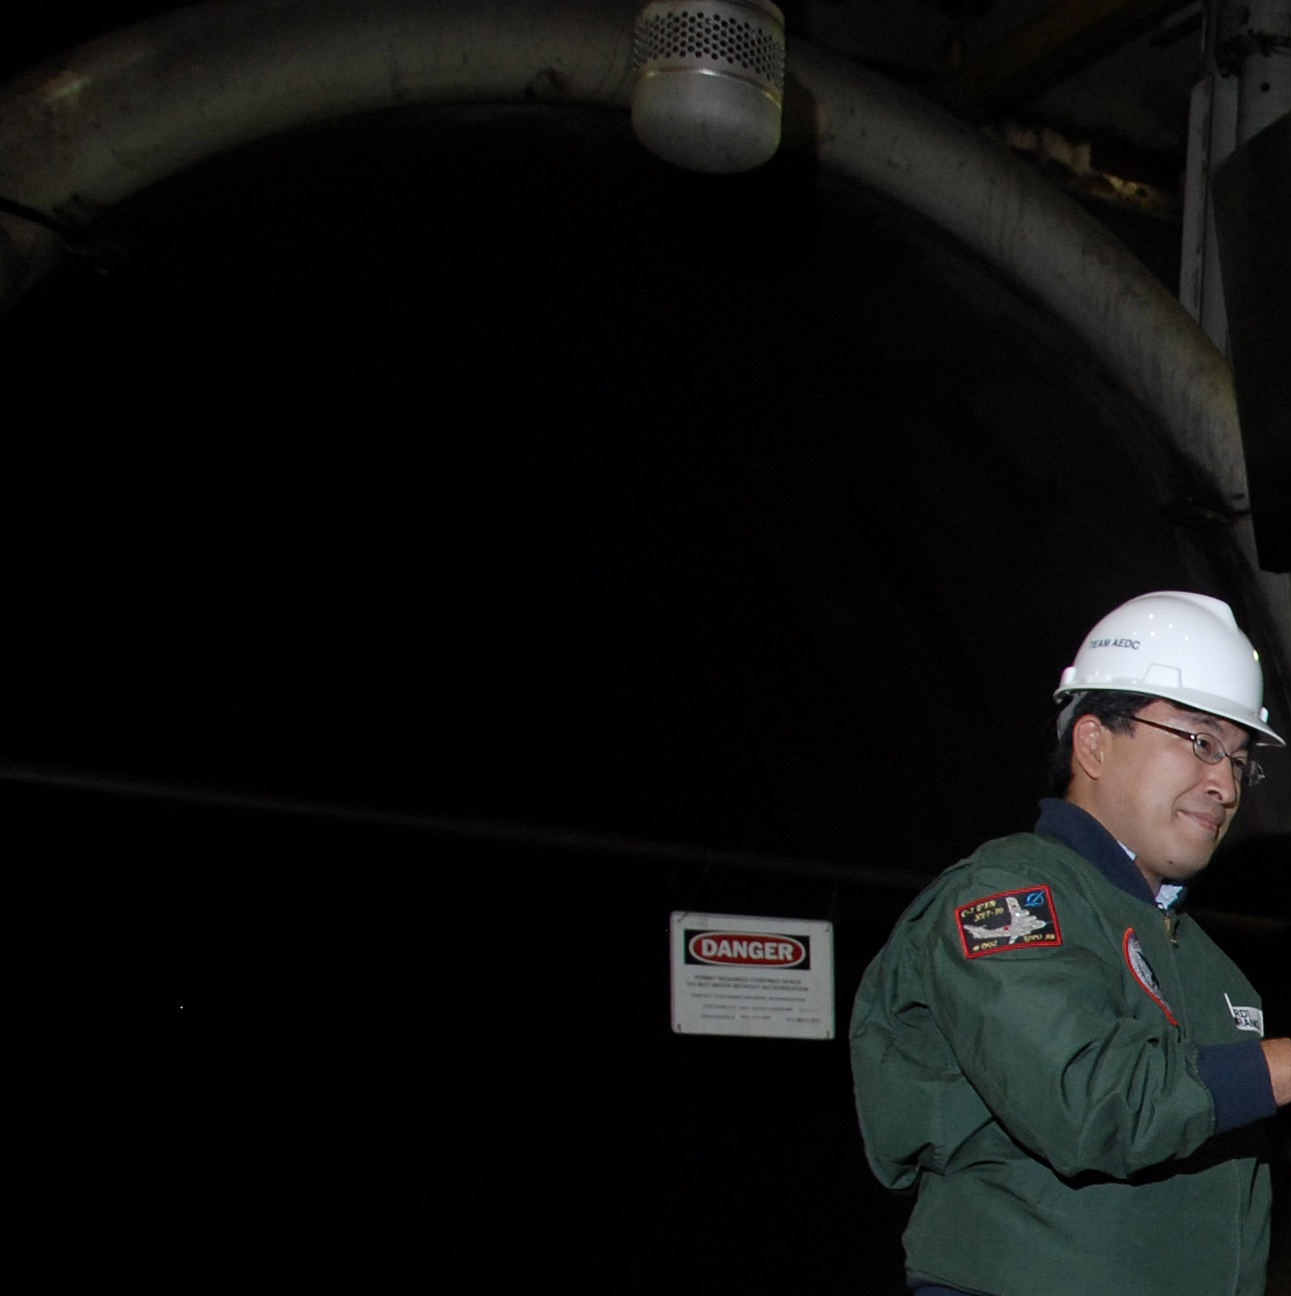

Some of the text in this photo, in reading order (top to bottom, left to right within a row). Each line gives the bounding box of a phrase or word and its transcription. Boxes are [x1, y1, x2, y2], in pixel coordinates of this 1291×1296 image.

[1089, 638, 1141, 650] TEAM AEDC
[701, 938, 794, 961] DANGER
